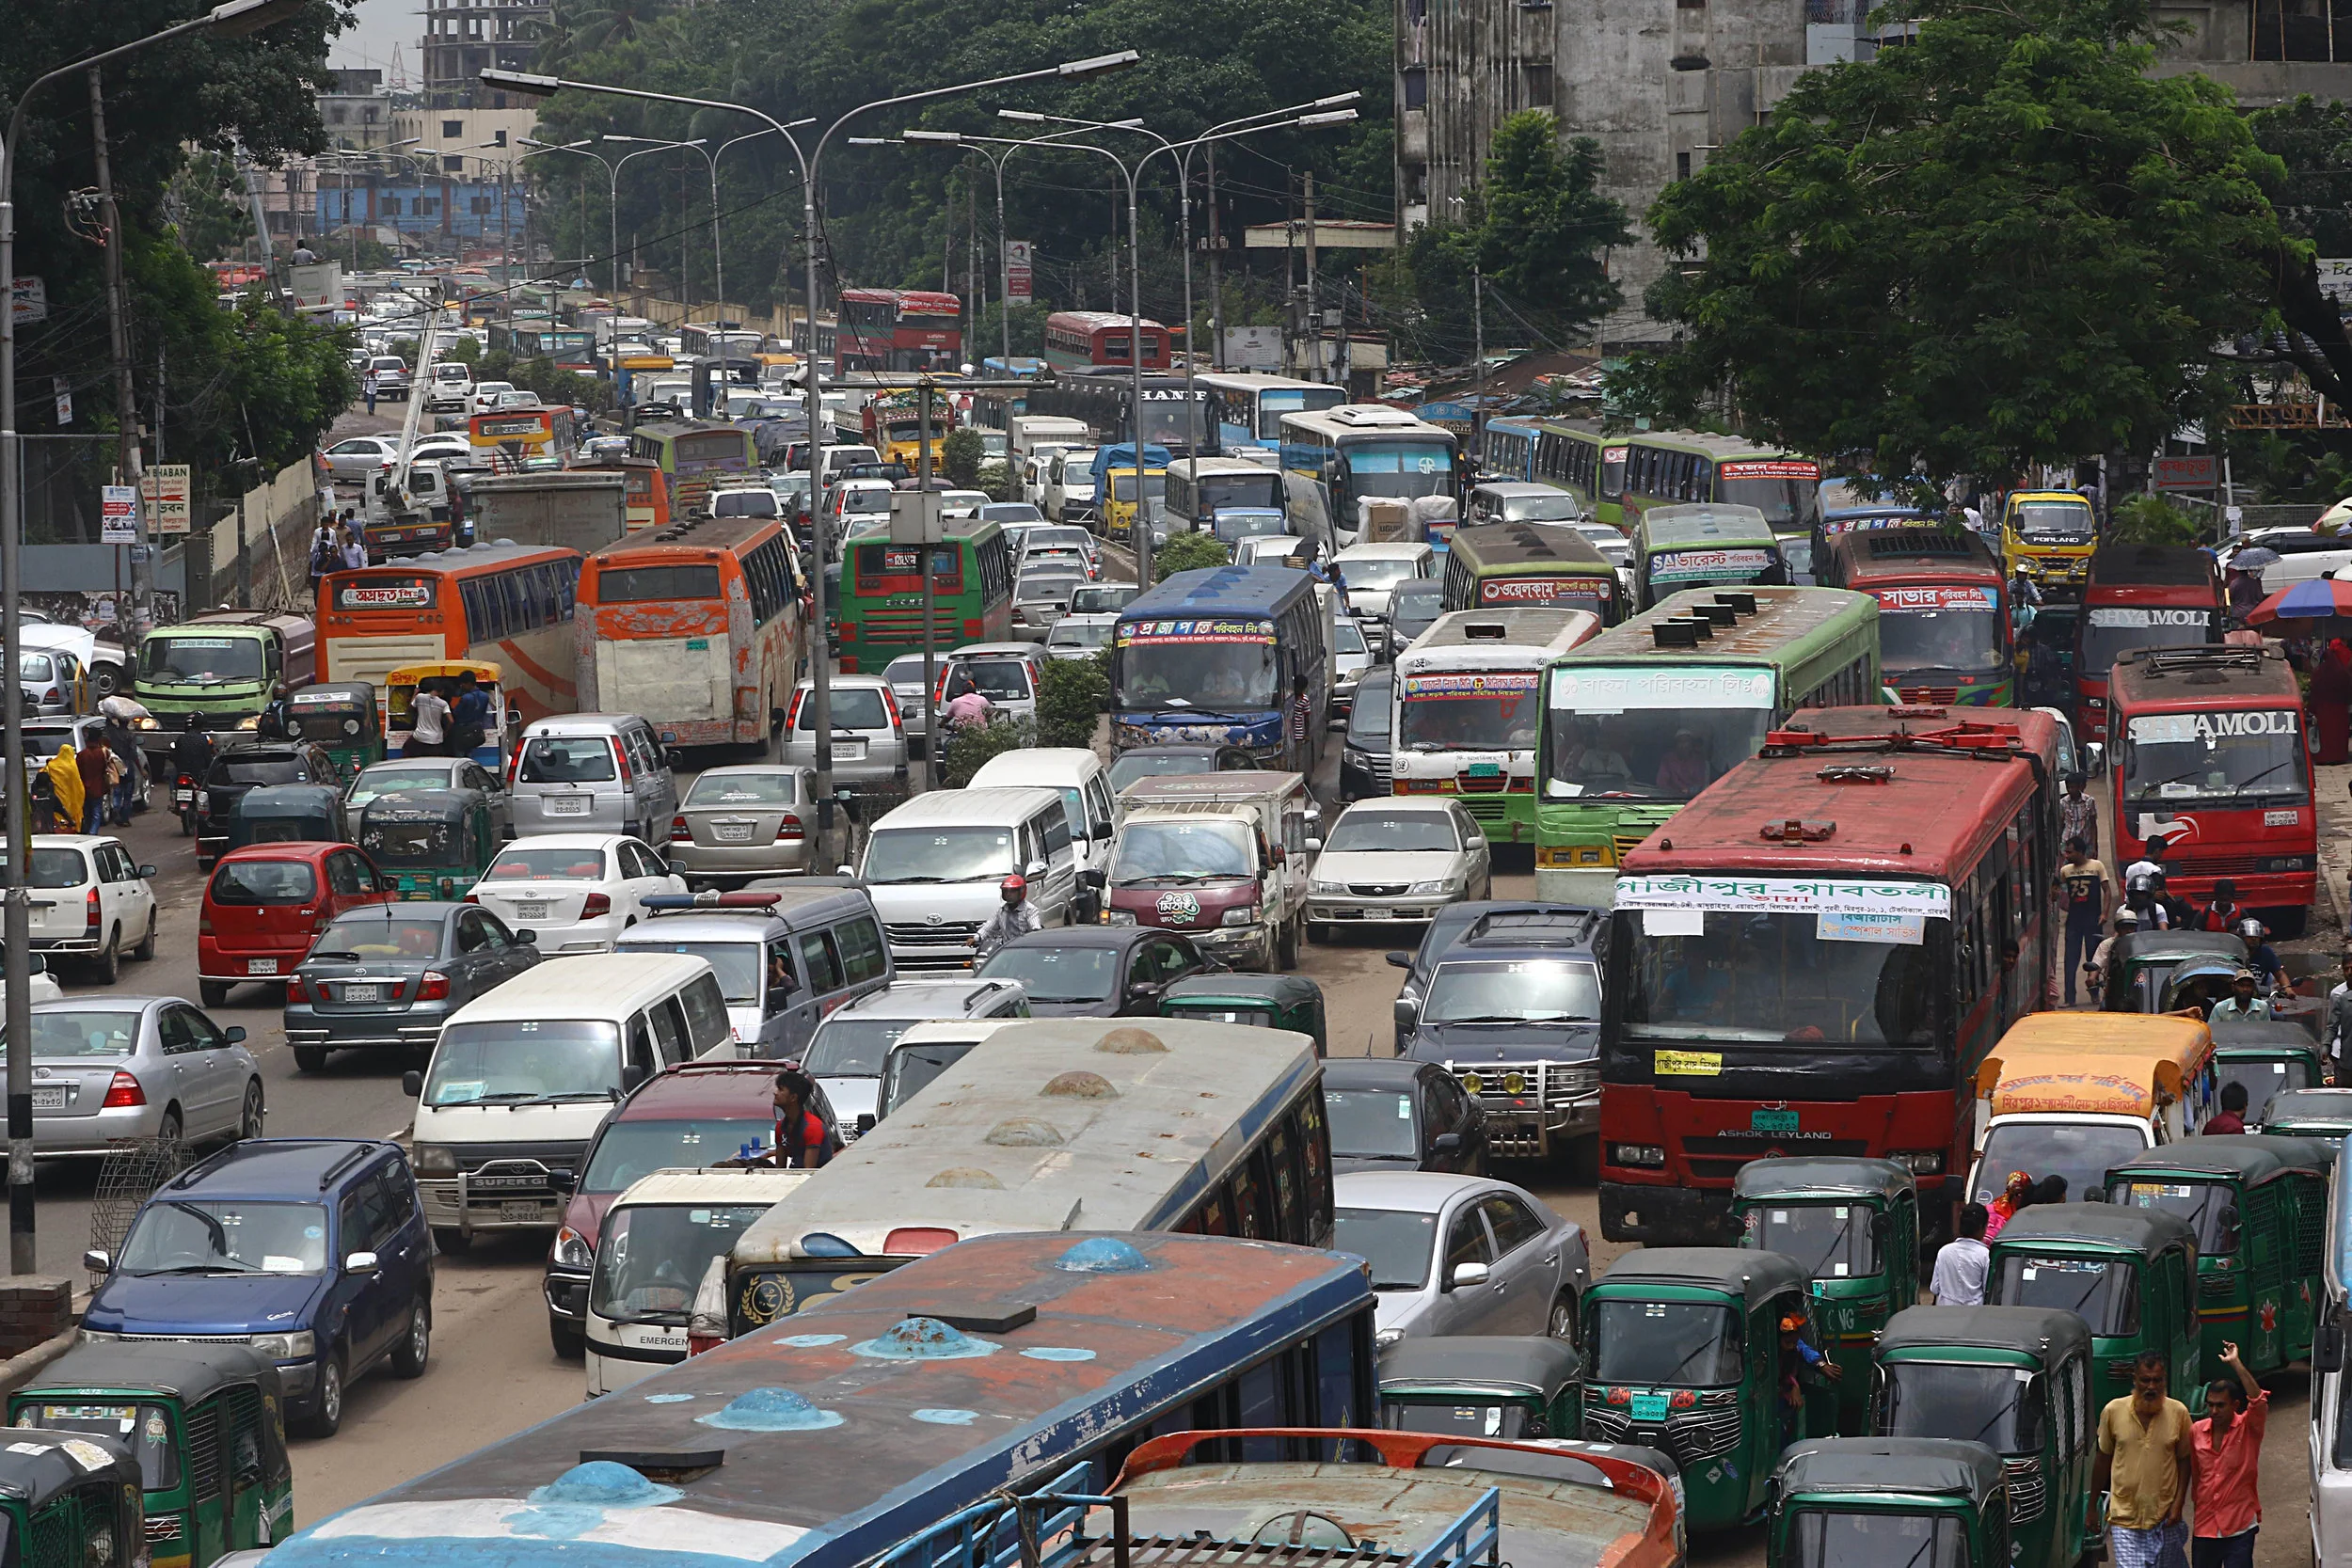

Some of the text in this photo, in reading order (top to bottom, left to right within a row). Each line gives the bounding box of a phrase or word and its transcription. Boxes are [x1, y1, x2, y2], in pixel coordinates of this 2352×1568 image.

[356, 589, 398, 603] অগ্রদূত
[1500, 582, 1555, 598] ওয়েলকাম
[1881, 589, 1939, 608] সাভার
[1940, 589, 1967, 599] পরিবহন
[2089, 610, 2210, 627] SHYAMOLI
[1139, 621, 1213, 636] প্রজাপতি
[1214, 622, 1243, 634] পরিবহন
[1581, 673, 1752, 695] বাহন পরিবহন লিঃ
[2128, 712, 2297, 740] SHYAMOLI
[1656, 1055, 1681, 1071] গাজীপুর
[1684, 1058, 1697, 1069] বাস
[1718, 1130, 1832, 1139] ASHOK LEYLAND
[640, 1336, 688, 1346] EMERGEN
